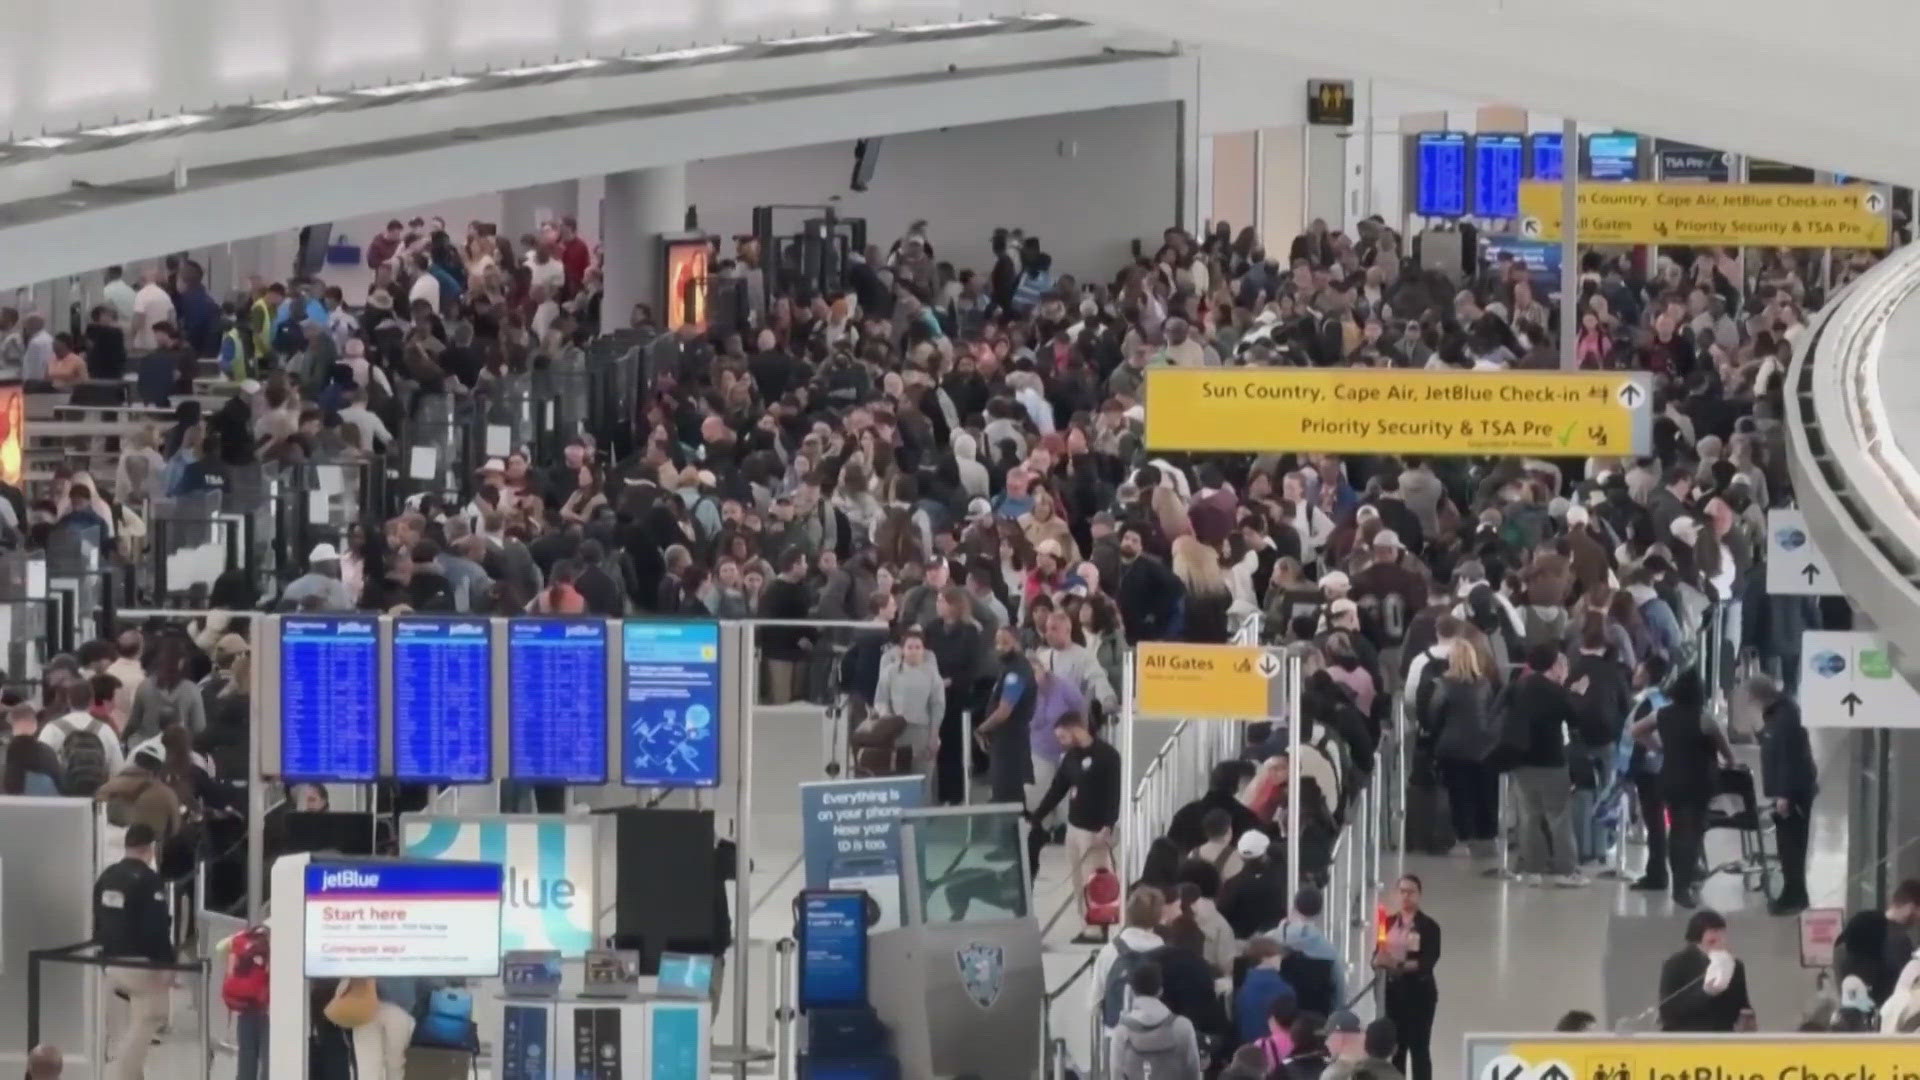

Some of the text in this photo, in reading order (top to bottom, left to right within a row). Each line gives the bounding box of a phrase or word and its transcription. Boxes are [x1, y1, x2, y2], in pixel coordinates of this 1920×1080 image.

[1657, 194, 1691, 206] Cape
[1723, 196, 1771, 207] JetBlue
[1777, 196, 1836, 207] Check-in
[1593, 218, 1632, 230] Gates
[1676, 219, 1861, 235] Priority Security & TSA Pre
[1202, 381, 1580, 403] Sun Country, Cape Air, JetBlue Check-in
[1301, 417, 1553, 439] Priority Security & TSA Pre
[1145, 656, 1214, 670] All Gates
[822, 791, 888, 805] Everything
[817, 810, 833, 822] on
[836, 809, 862, 822] your
[863, 823, 890, 836] your
[322, 869, 380, 892] jetBlue
[502, 866, 575, 910] lue
[323, 906, 407, 921] Start here
